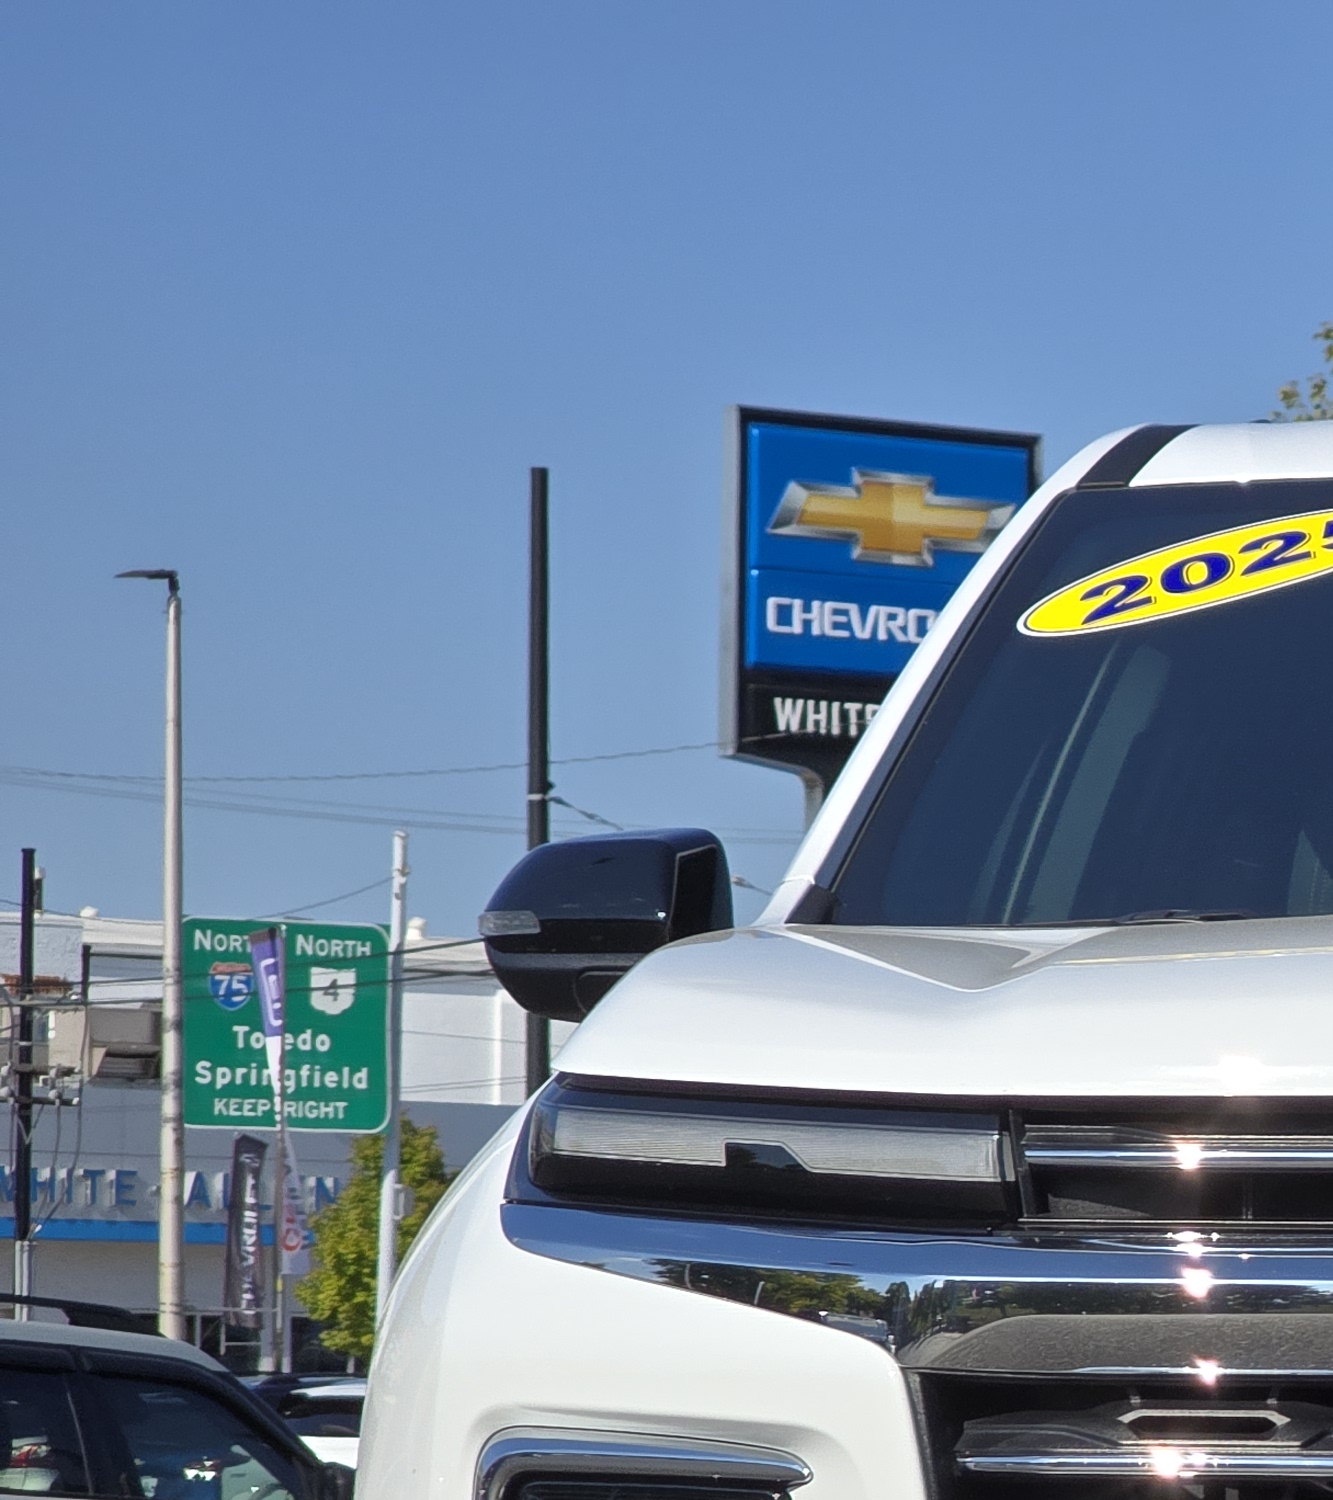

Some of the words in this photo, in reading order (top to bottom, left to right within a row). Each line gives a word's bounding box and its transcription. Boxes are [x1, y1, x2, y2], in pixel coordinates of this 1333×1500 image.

[766, 596, 939, 644] CHEVRO
[193, 929, 251, 953] NORT
[295, 934, 371, 957] NORTH
[214, 975, 249, 1002] 75
[322, 978, 340, 1002] 4
[232, 1025, 331, 1052] Toedo
[194, 1060, 369, 1093] Springfield
[213, 1097, 270, 1117] KEEP
[283, 1101, 348, 1120] RIGHT
